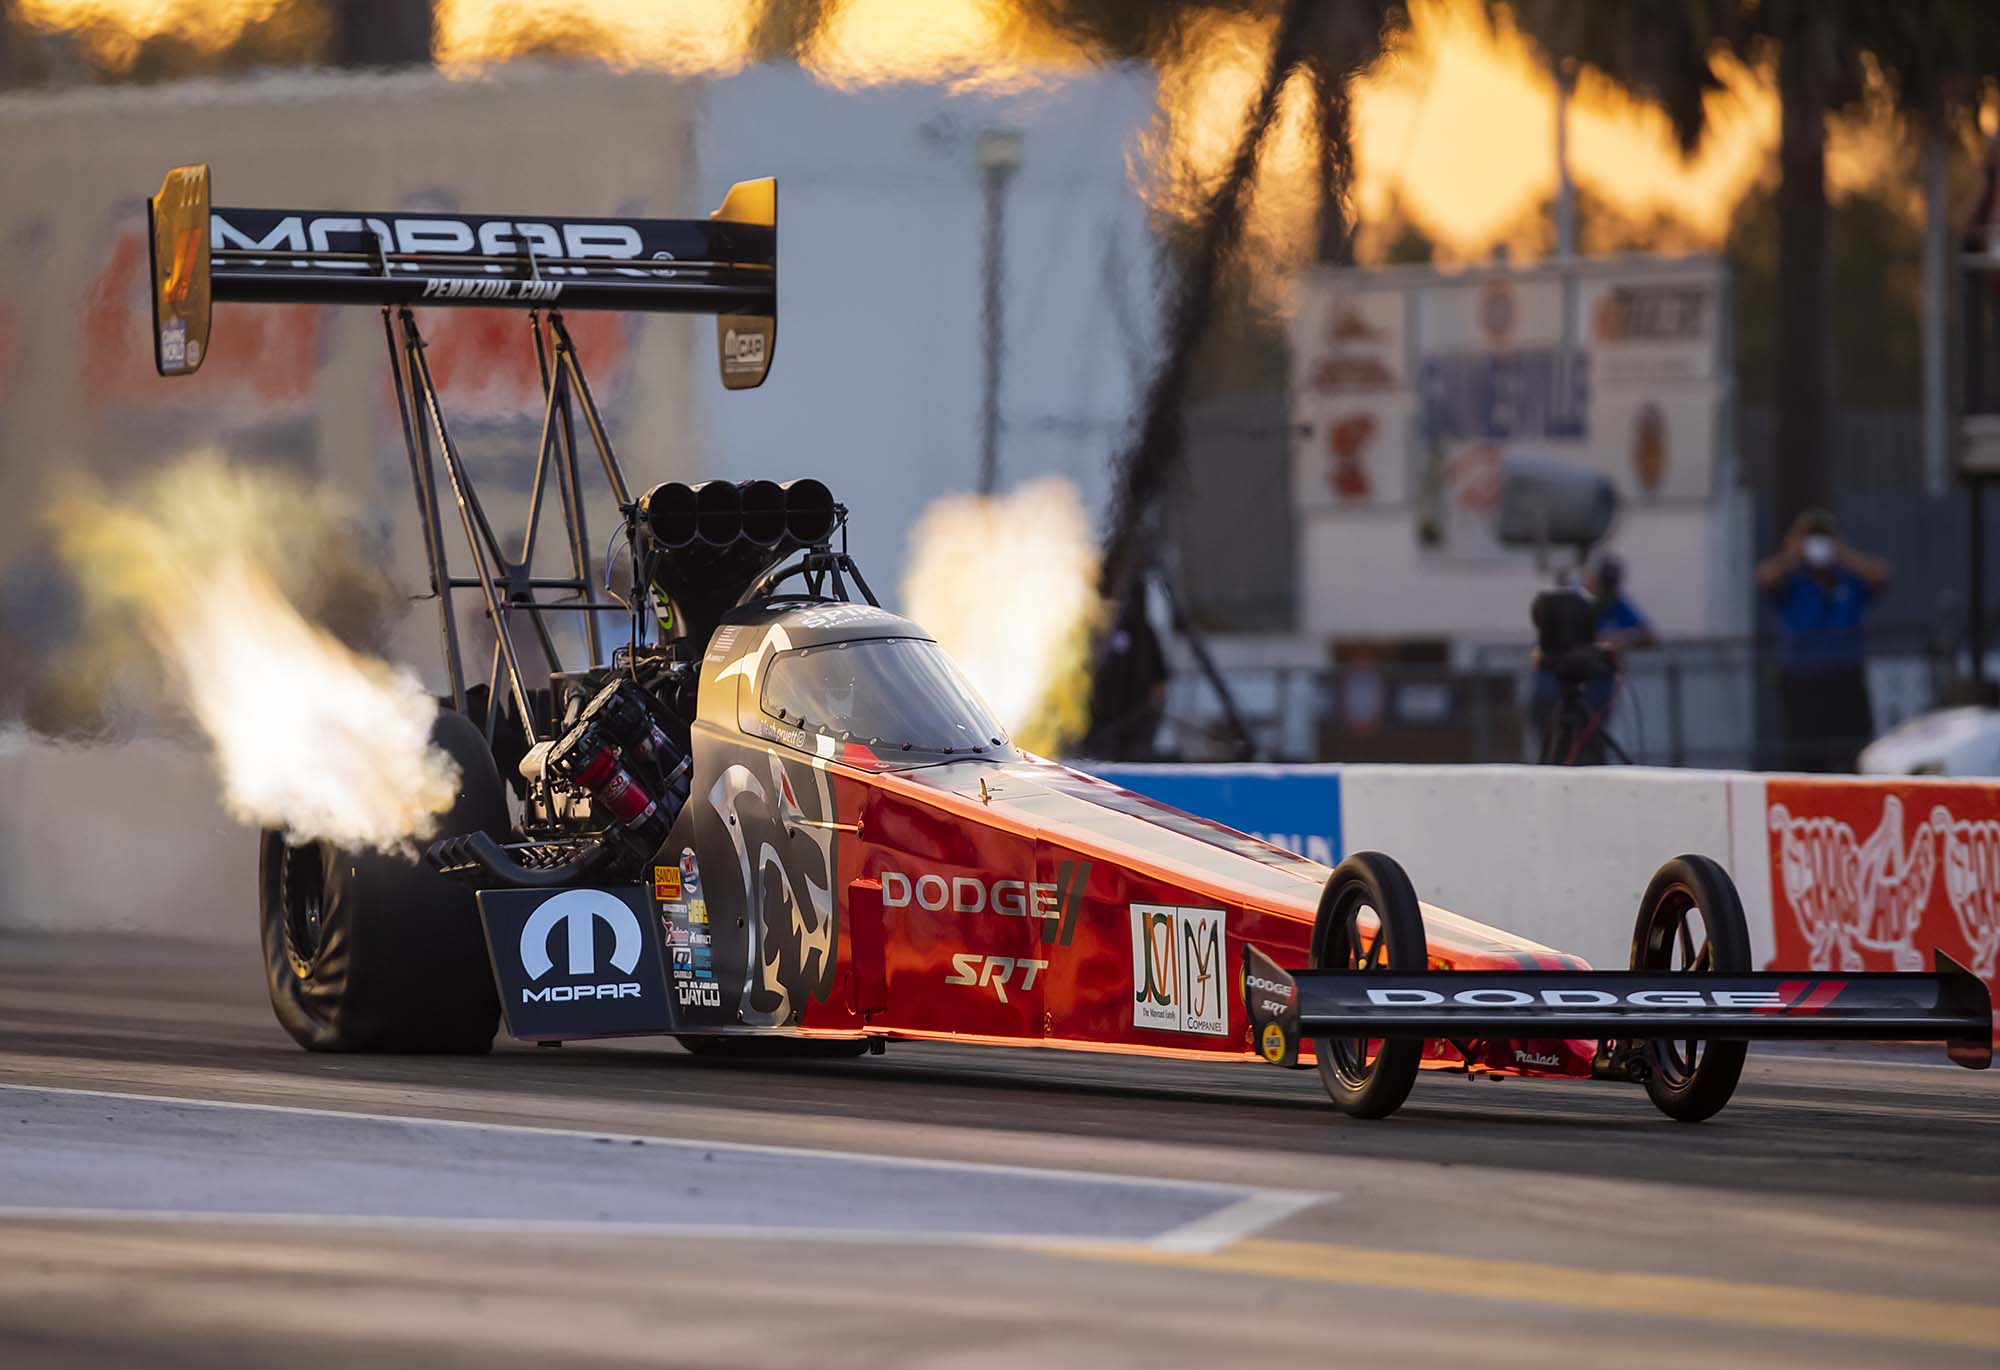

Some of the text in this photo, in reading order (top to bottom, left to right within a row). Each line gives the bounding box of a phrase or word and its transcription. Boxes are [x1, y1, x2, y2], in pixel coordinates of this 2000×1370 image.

[422, 278, 564, 300] PENNZOIL.COM
[655, 867, 681, 883] SANDVIK
[881, 871, 1061, 919] DODGE
[945, 953, 1049, 1004] SRT
[1246, 975, 1292, 997] DODGE
[522, 982, 642, 1003] MOPAR
[678, 981, 721, 1007] DAYCO
[1366, 989, 1788, 1007] DODGE
[1261, 1000, 1288, 1016] SRT
